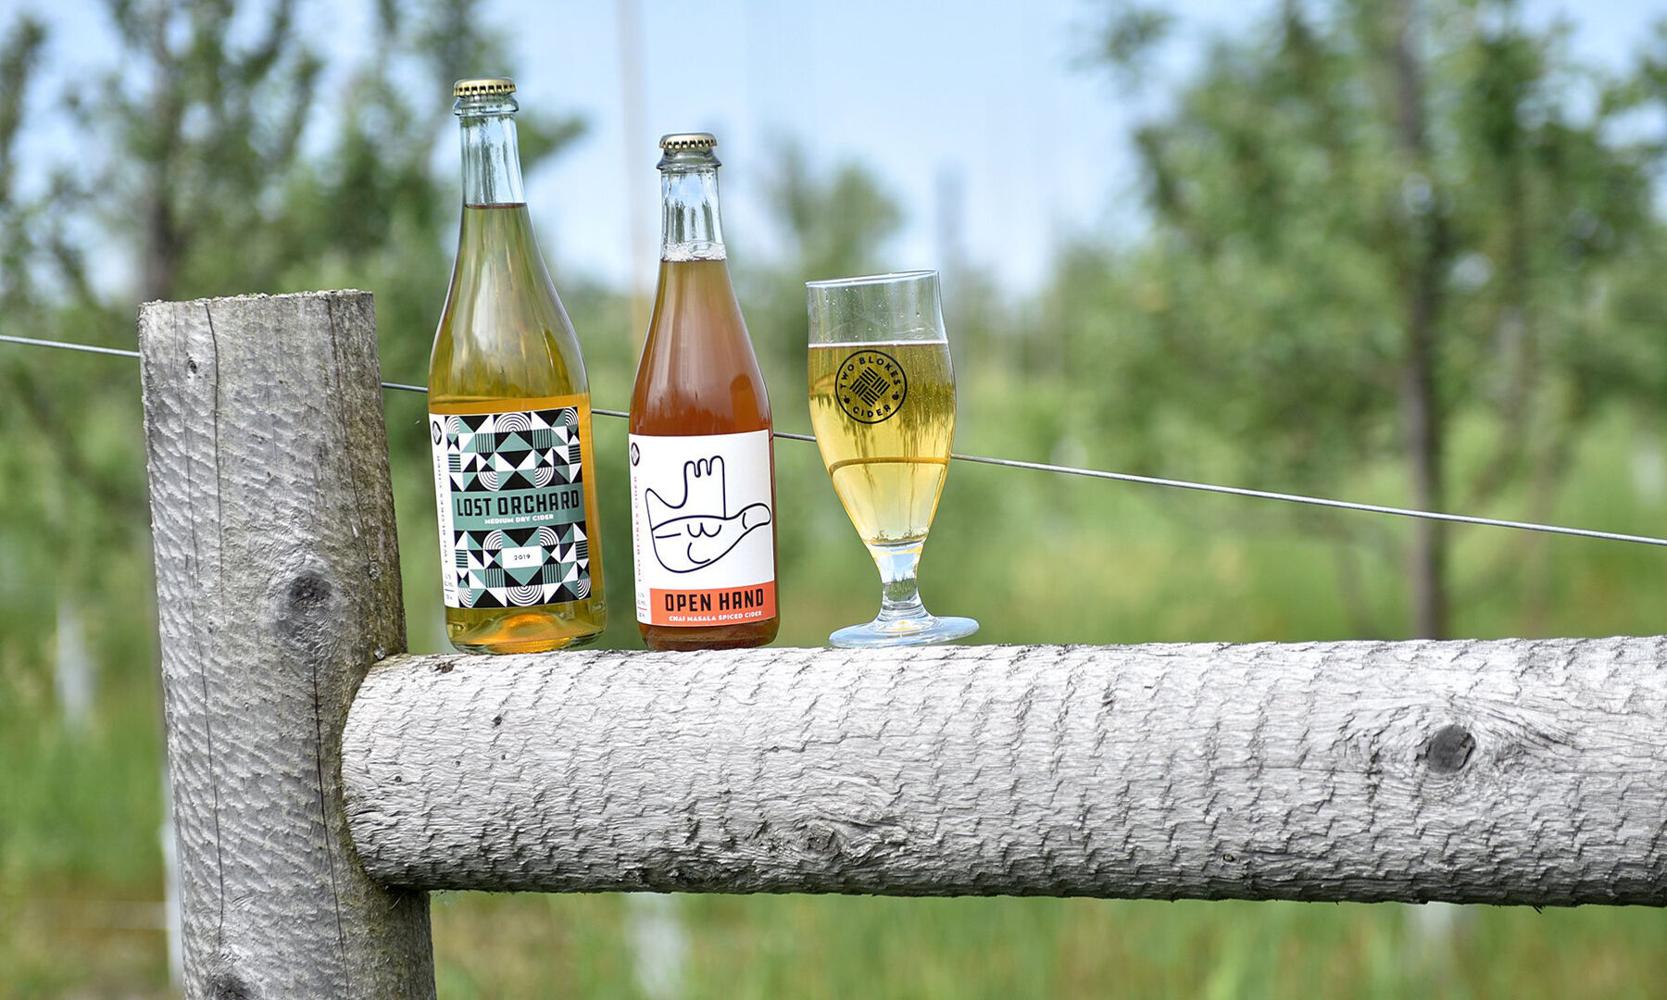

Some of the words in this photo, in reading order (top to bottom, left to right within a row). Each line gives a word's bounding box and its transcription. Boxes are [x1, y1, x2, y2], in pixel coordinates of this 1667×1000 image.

[840, 364, 854, 389] TWO
[858, 356, 901, 386] BLOKES
[853, 404, 891, 417] CIDER
[456, 497, 492, 517] LOST
[497, 490, 580, 515] ORCHARD
[484, 517, 514, 525] MEDIUM
[515, 515, 531, 523] DRY
[531, 513, 554, 522] CIDER
[665, 593, 712, 612] OPEN
[719, 588, 764, 611] HAND
